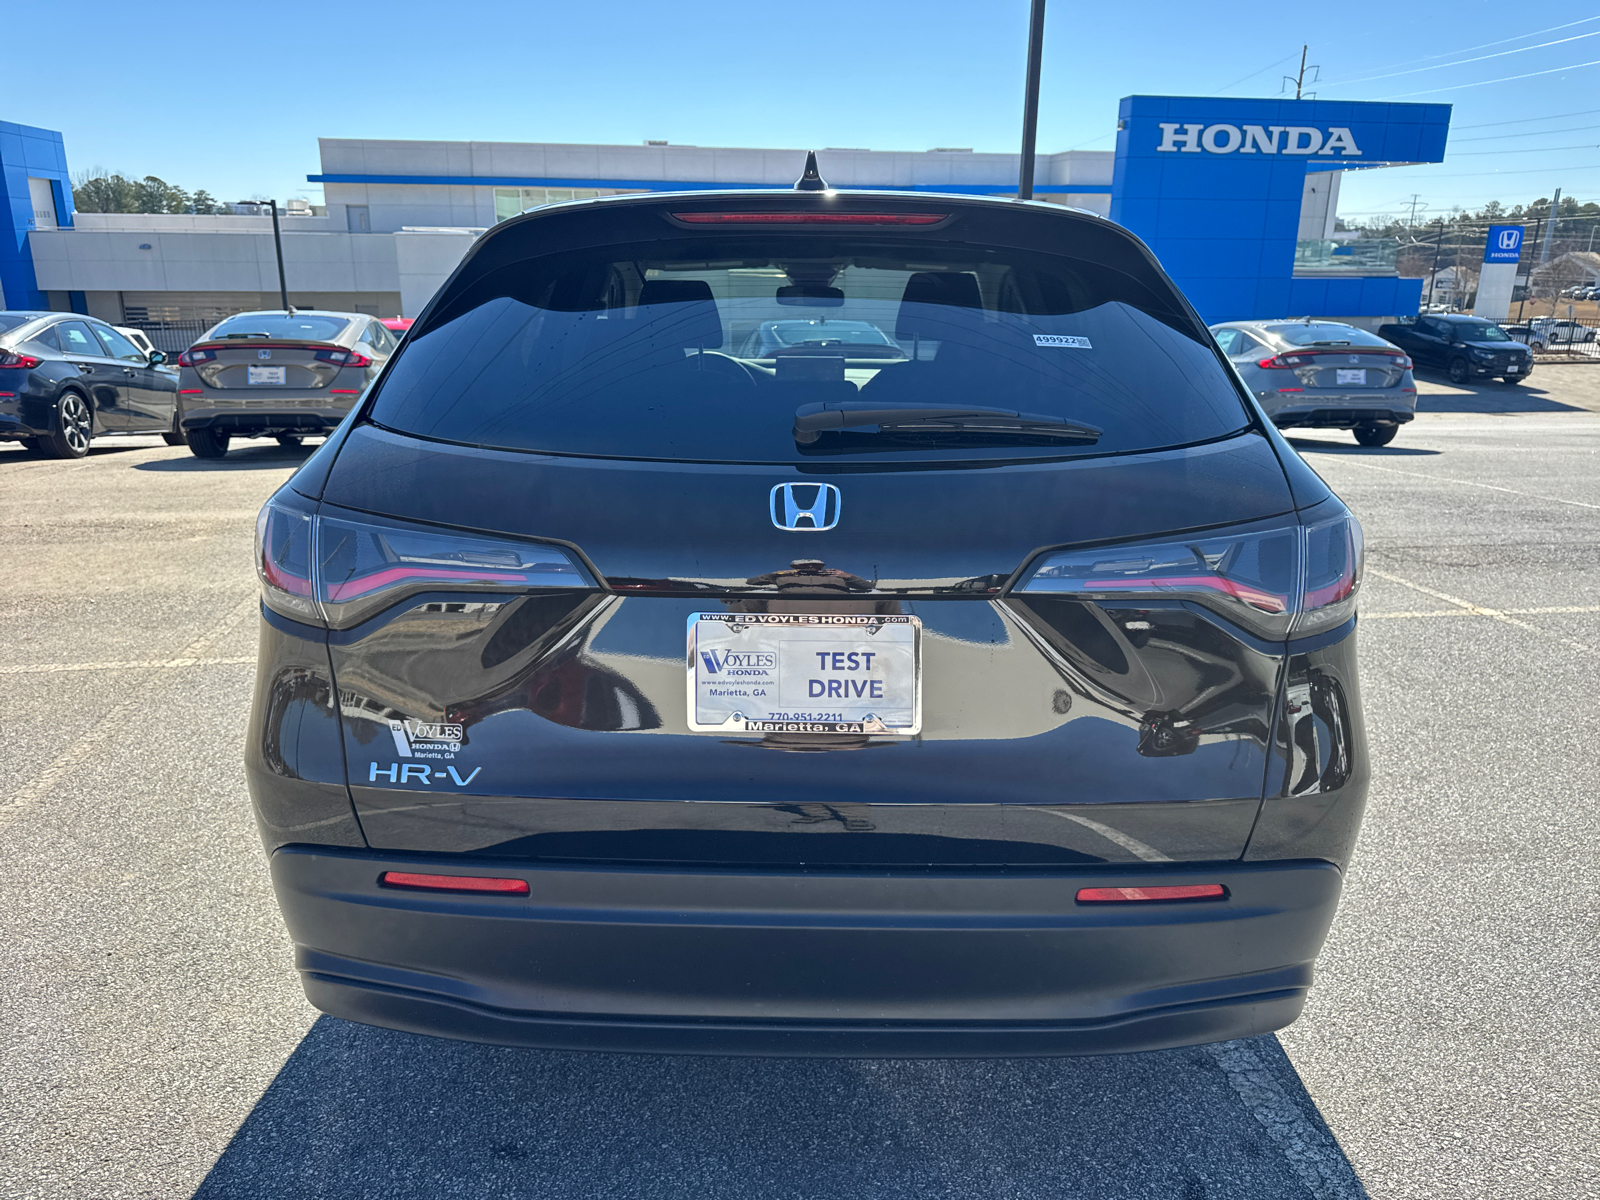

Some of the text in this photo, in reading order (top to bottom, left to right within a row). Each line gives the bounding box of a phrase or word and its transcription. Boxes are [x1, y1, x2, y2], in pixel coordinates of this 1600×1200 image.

[1157, 123, 1362, 156] HONDA
[758, 615, 819, 623] VOYLES
[821, 616, 879, 624] HONDA
[709, 649, 773, 671] VOYLES
[816, 652, 876, 671] TEST
[709, 689, 767, 697] Marietta, GA
[808, 679, 884, 698] DRIVE
[768, 712, 843, 721] 770-951-2211
[403, 720, 461, 742] VOYLES
[748, 721, 862, 732] Marietta, GA
[369, 762, 482, 786] HR-V
